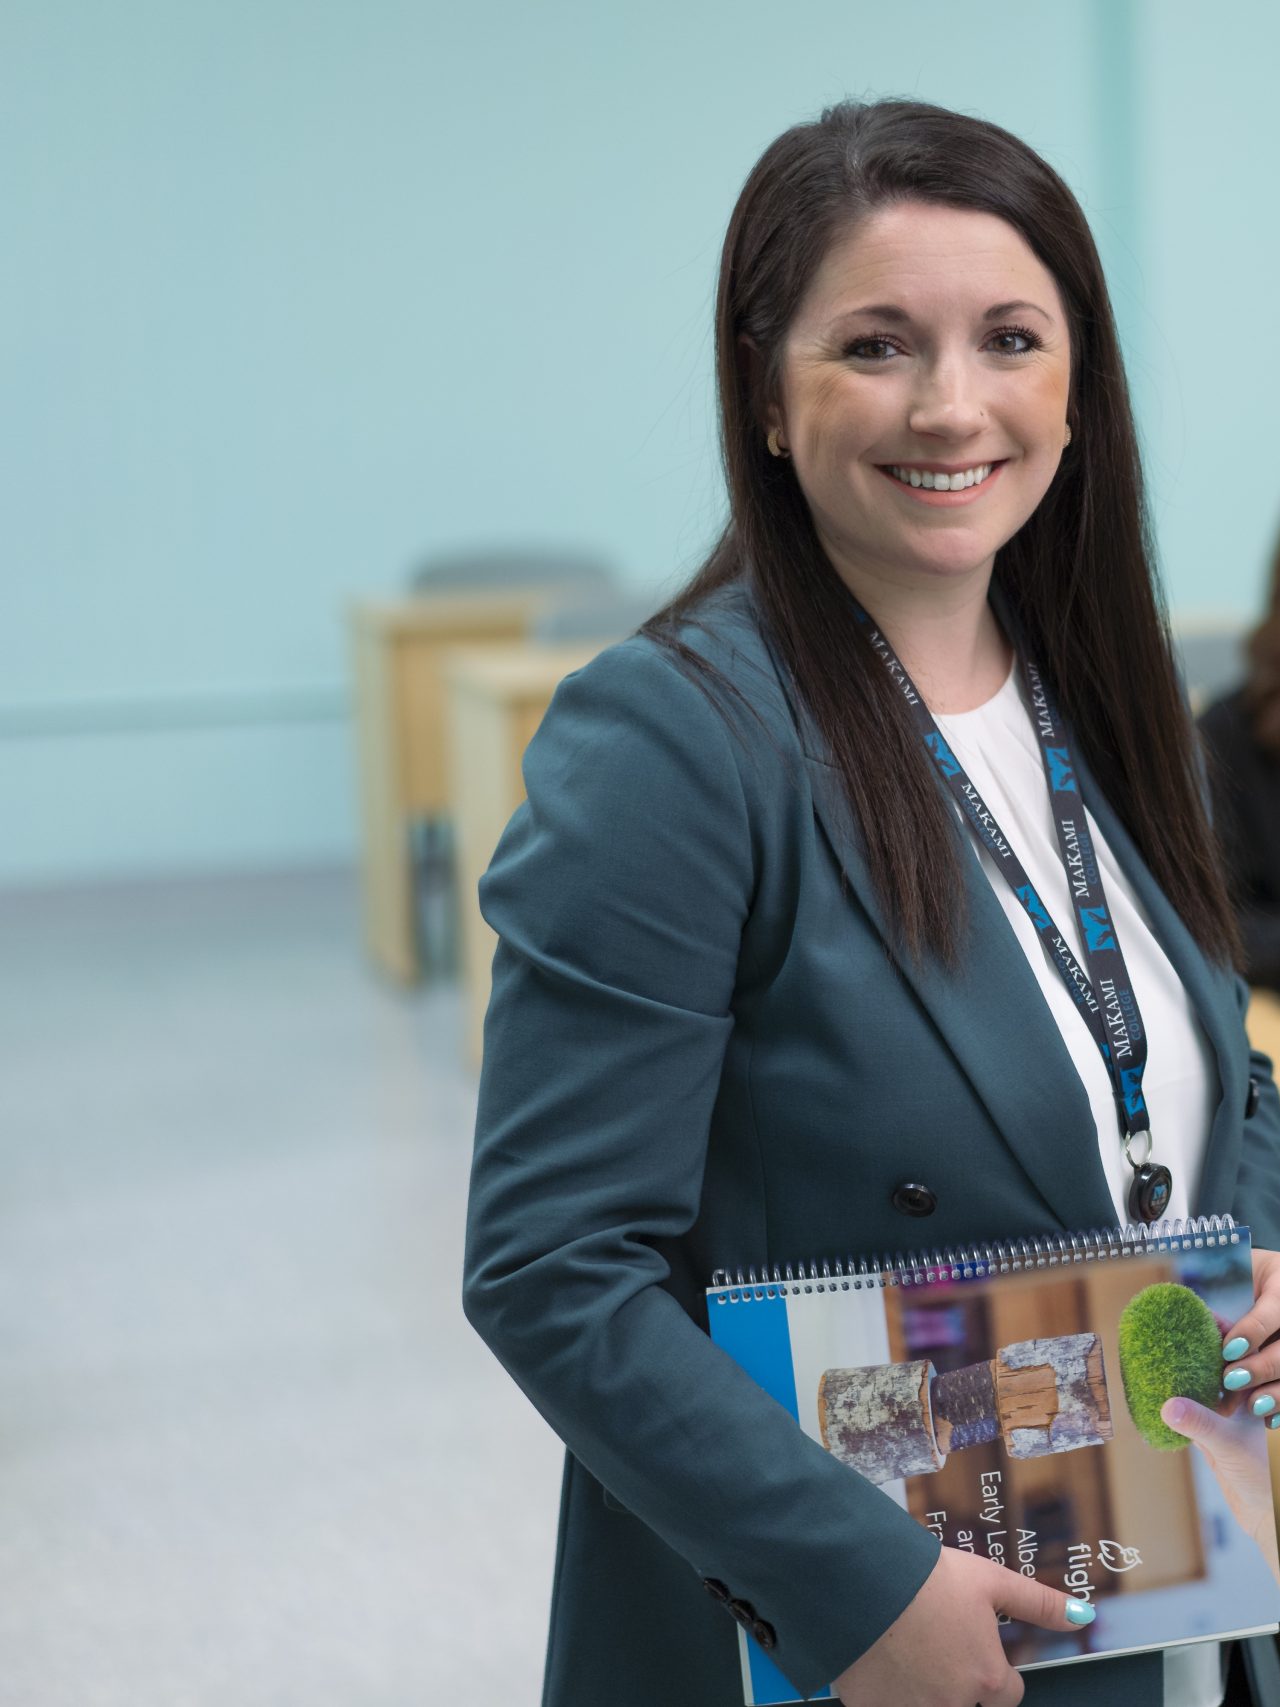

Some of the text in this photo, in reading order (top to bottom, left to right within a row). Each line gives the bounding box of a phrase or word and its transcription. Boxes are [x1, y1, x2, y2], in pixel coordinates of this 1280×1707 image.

[870, 630, 919, 705] MAKAMI
[1027, 662, 1055, 738] MAKAMI
[961, 783, 1012, 858] MAKAMI
[1061, 820, 1090, 898] MAKAMI
[1052, 936, 1099, 1013] MAKAMI
[1100, 979, 1132, 1060] MAKAMI
[1120, 989, 1141, 1040] COLLEGE
[979, 1471, 1004, 1523] Early
[1064, 1543, 1096, 1607] fligh
